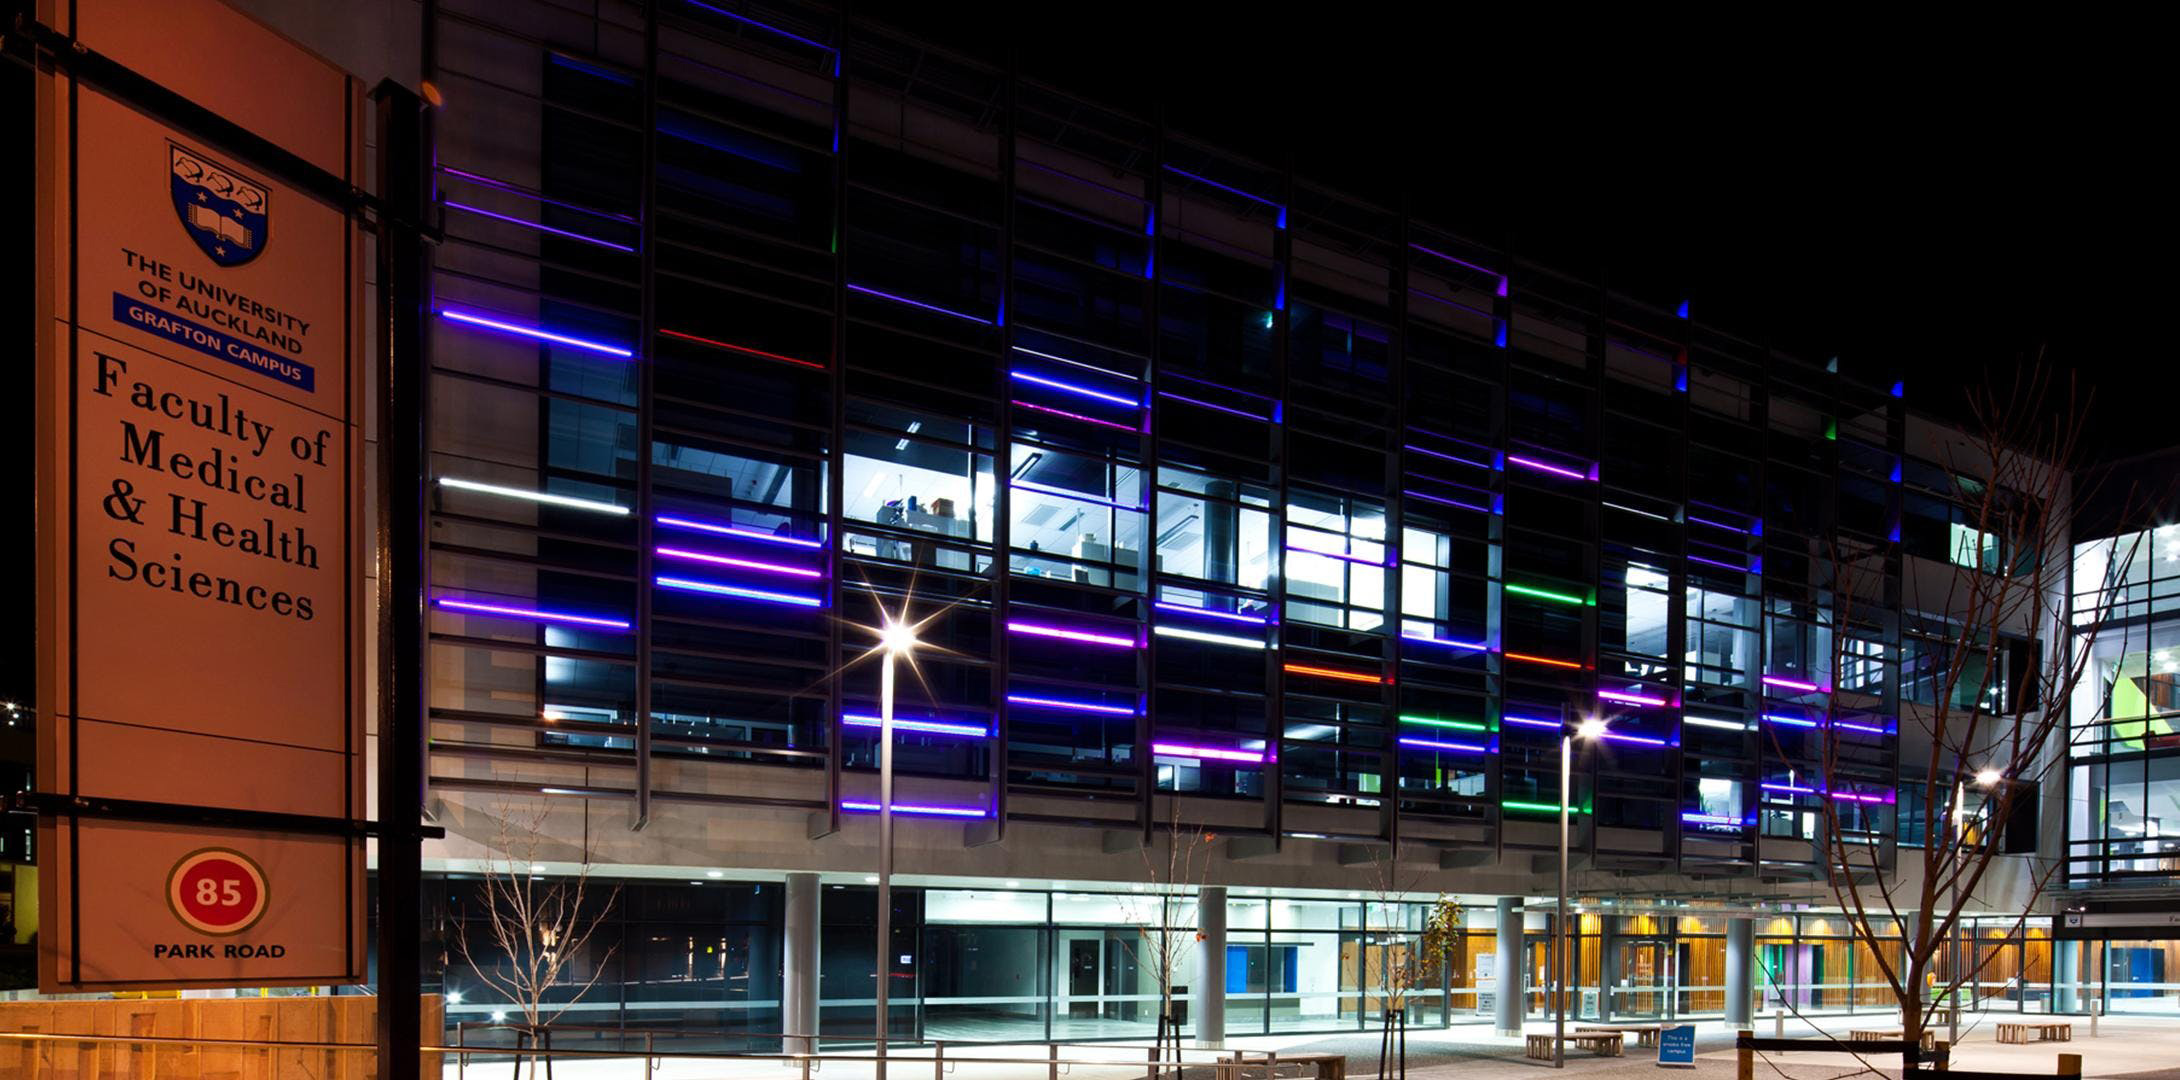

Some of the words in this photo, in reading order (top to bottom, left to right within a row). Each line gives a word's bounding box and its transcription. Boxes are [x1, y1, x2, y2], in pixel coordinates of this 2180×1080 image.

[122, 248, 171, 282] THE
[179, 271, 310, 336] UNIVERSITY
[138, 280, 171, 302] OF
[176, 295, 302, 354] AUCKLAND
[128, 306, 221, 351] GRAFTON
[227, 343, 302, 381] CAMPUS
[93, 350, 274, 457] Faculty
[291, 430, 331, 467] of
[120, 419, 307, 513] Medical
[103, 478, 147, 525] &
[168, 493, 320, 570] Health
[108, 538, 314, 621] Sciences
[196, 878, 242, 906] 85
[154, 944, 216, 959] PARK
[224, 944, 286, 959] ROAD
